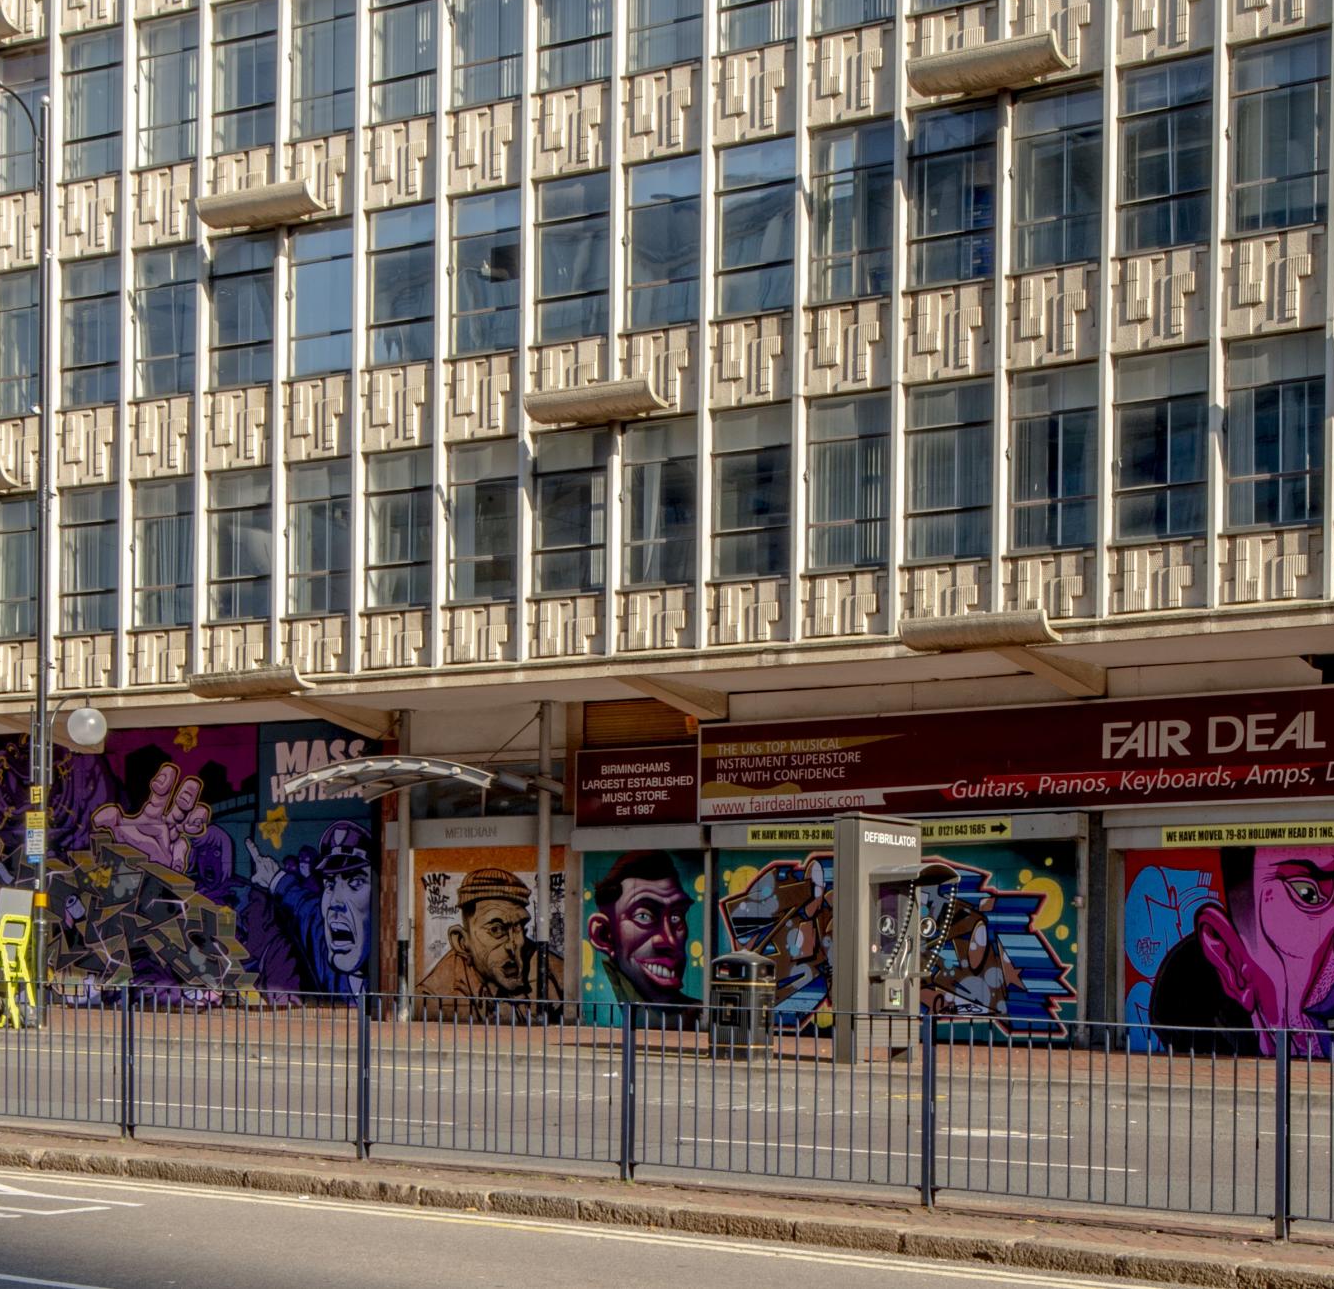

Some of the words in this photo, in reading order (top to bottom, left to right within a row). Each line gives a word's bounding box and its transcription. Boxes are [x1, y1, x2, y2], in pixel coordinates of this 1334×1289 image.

[1101, 719, 1191, 759] FAIR
[1207, 711, 1326, 754] DEAL
[717, 743, 739, 755] THE
[741, 743, 762, 754] UKs
[766, 741, 787, 753] TOP
[789, 738, 842, 752] MUSICAL
[275, 739, 365, 773] MASS
[716, 755, 788, 769] INSTRUMENT
[790, 751, 861, 766] SUPERSTORE
[601, 762, 671, 775] BIRMINGHAMS
[717, 772, 739, 784] BUY
[741, 771, 770, 783] WITH
[774, 767, 845, 781] CONFIDENCE
[582, 778, 625, 790] LARGEST
[627, 775, 694, 789] ESTABLISHED
[951, 778, 1029, 799] Guitars,
[1037, 776, 1111, 795] Pianos,
[1119, 766, 1237, 795] Keyboards,
[1244, 764, 1315, 792] Amps,
[602, 791, 633, 803] MUSIC
[634, 790, 671, 802] STORE.
[749, 793, 865, 812] fairdealmusic.com
[616, 805, 631, 816] Est
[633, 804, 655, 815] 1987
[444, 826, 498, 840] MERIDIAN
[751, 830, 761, 840] WE
[762, 830, 777, 840] HAVE
[921, 826, 934, 837] ALK
[938, 826, 954, 836] 0121
[954, 825, 968, 835] 643
[969, 824, 986, 835] 1685
[1166, 831, 1177, 842] WE
[1178, 830, 1197, 842] HAVE
[1225, 829, 1247, 841] 79-83
[1248, 827, 1286, 840] HOLLOWAY
[1287, 827, 1307, 839] HEAD
[864, 830, 916, 848] DEFIBRILLATOR
